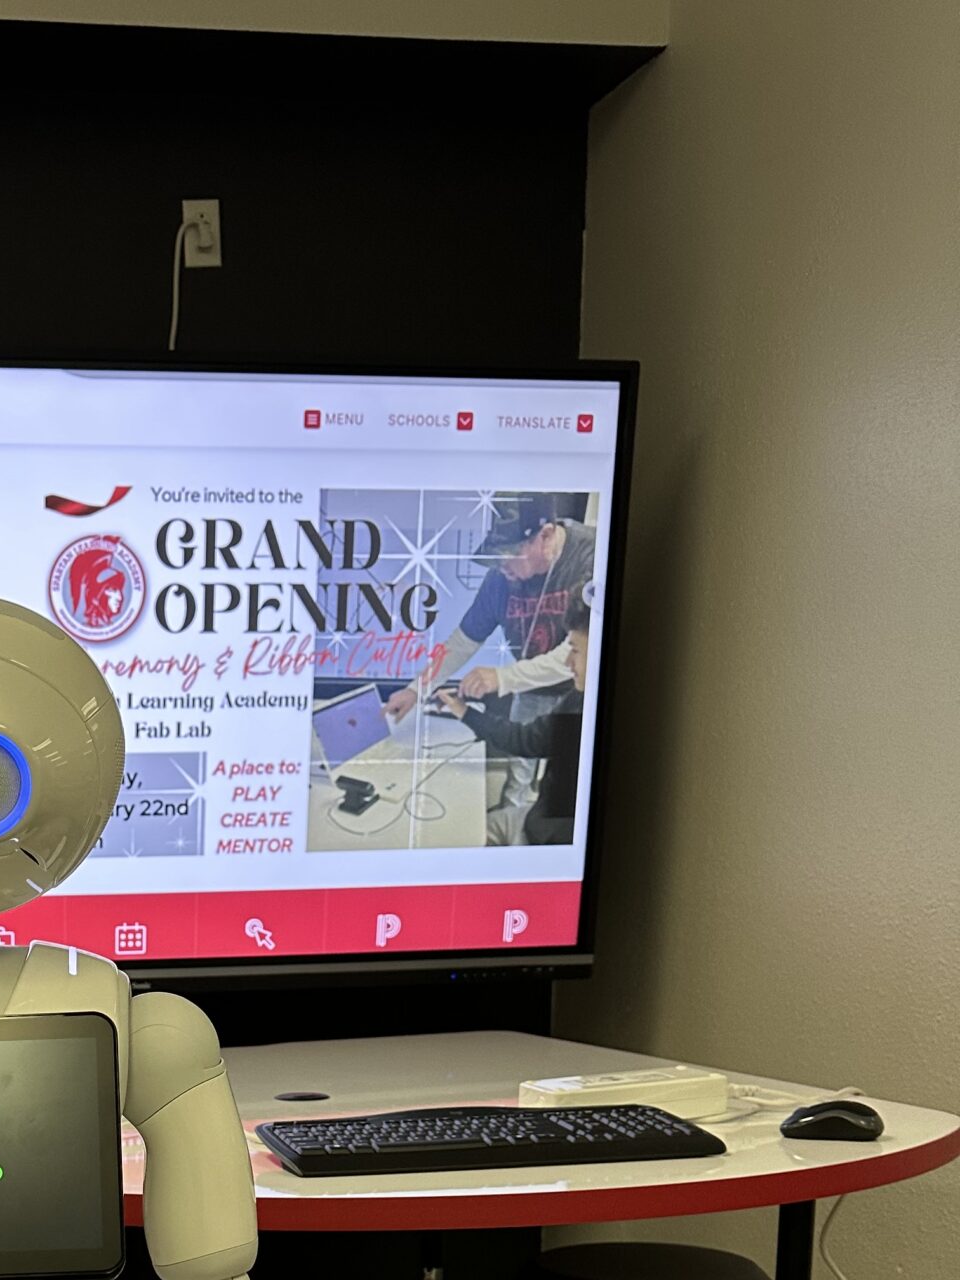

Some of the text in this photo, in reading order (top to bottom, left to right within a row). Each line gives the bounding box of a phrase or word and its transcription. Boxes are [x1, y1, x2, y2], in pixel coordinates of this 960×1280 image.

[325, 412, 364, 426] MENU
[387, 413, 450, 428] SCHOOLS
[497, 415, 570, 430] TRANSLATE
[150, 486, 303, 503] You're invited to the
[155, 517, 382, 571] GRAND
[154, 582, 440, 633] OPENING
[100, 629, 450, 692] remony & Ribbon Cutting
[128, 693, 214, 712] Learning
[220, 692, 308, 711] Academy
[135, 722, 212, 739] Fab Lab
[213, 760, 301, 779] A place to:
[232, 786, 282, 802] PLAY
[140, 799, 189, 816] 22nd
[220, 812, 292, 827] CREATE
[216, 838, 293, 854] MENTOR
